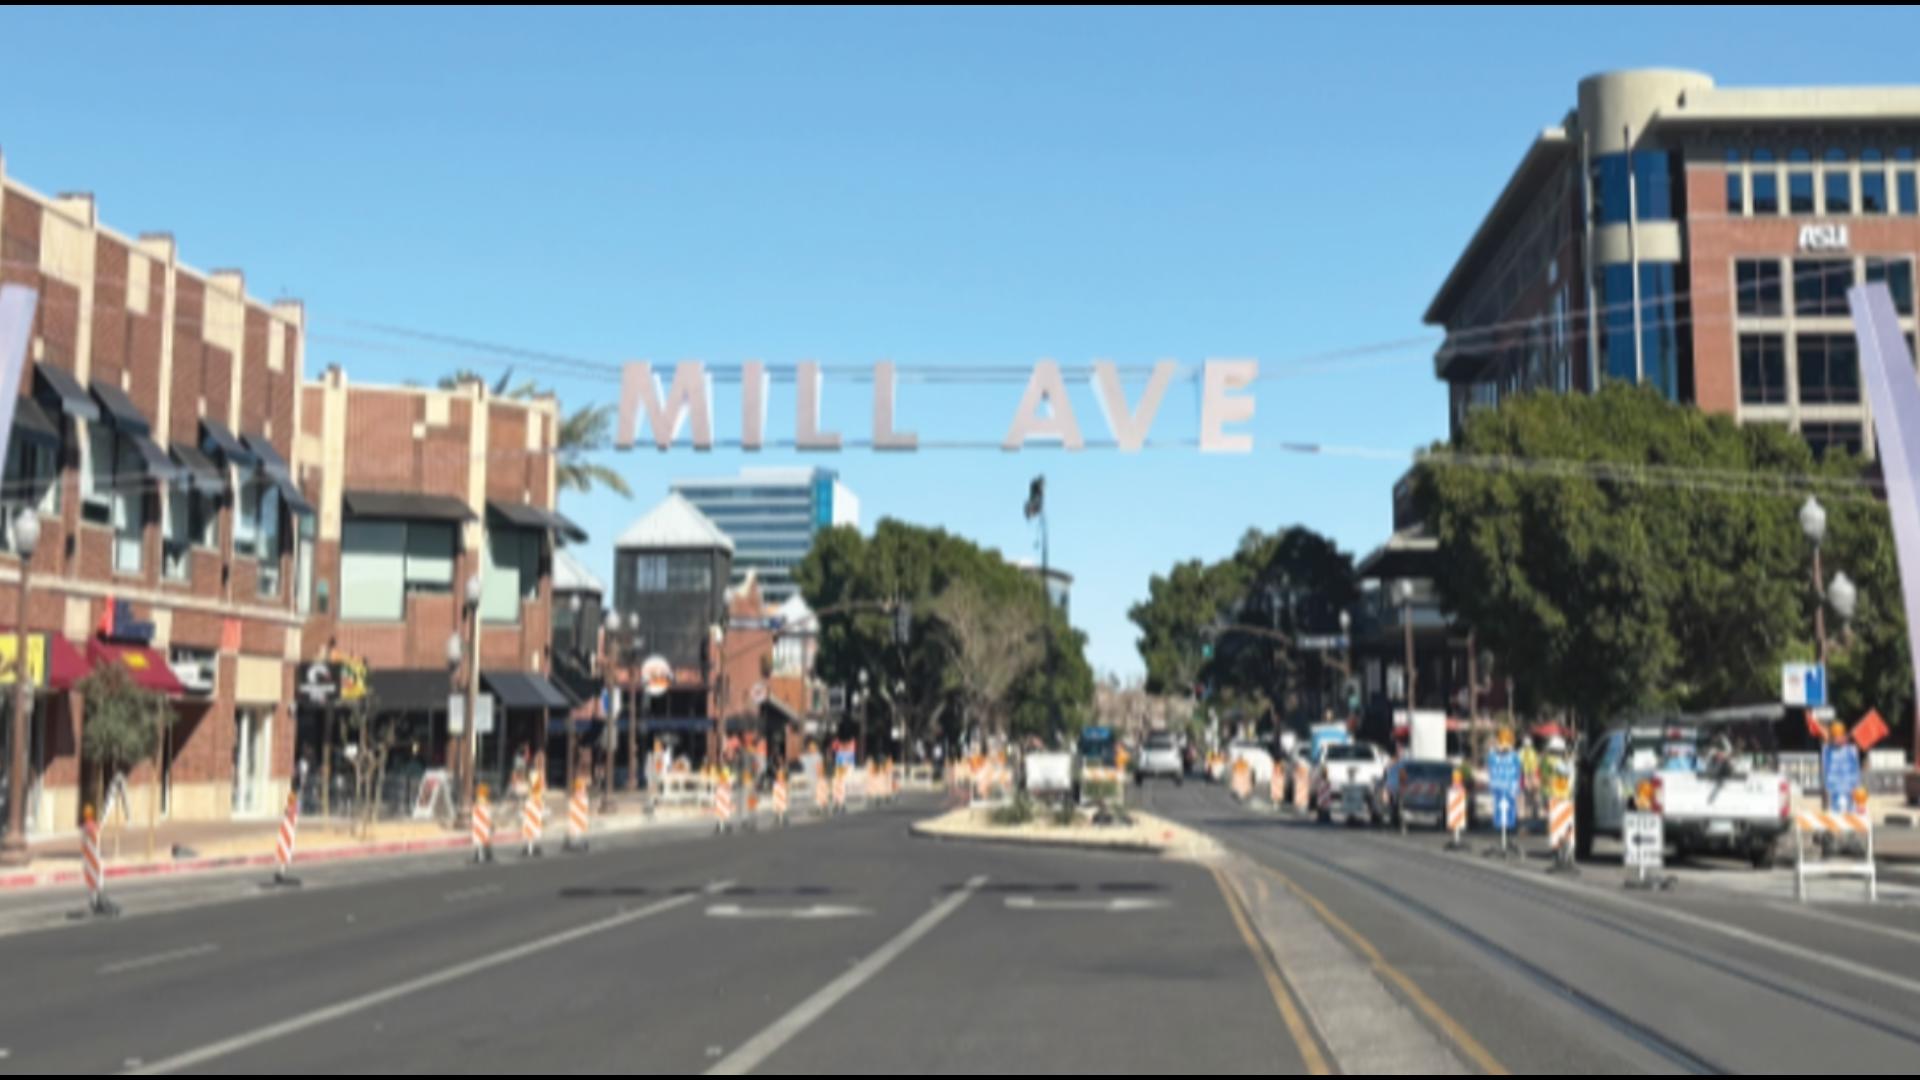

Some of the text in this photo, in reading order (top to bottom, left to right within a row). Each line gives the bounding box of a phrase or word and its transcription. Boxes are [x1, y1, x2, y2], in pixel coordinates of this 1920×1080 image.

[1799, 224, 1848, 249] ASU
[614, 358, 1260, 454] MILL AVE
